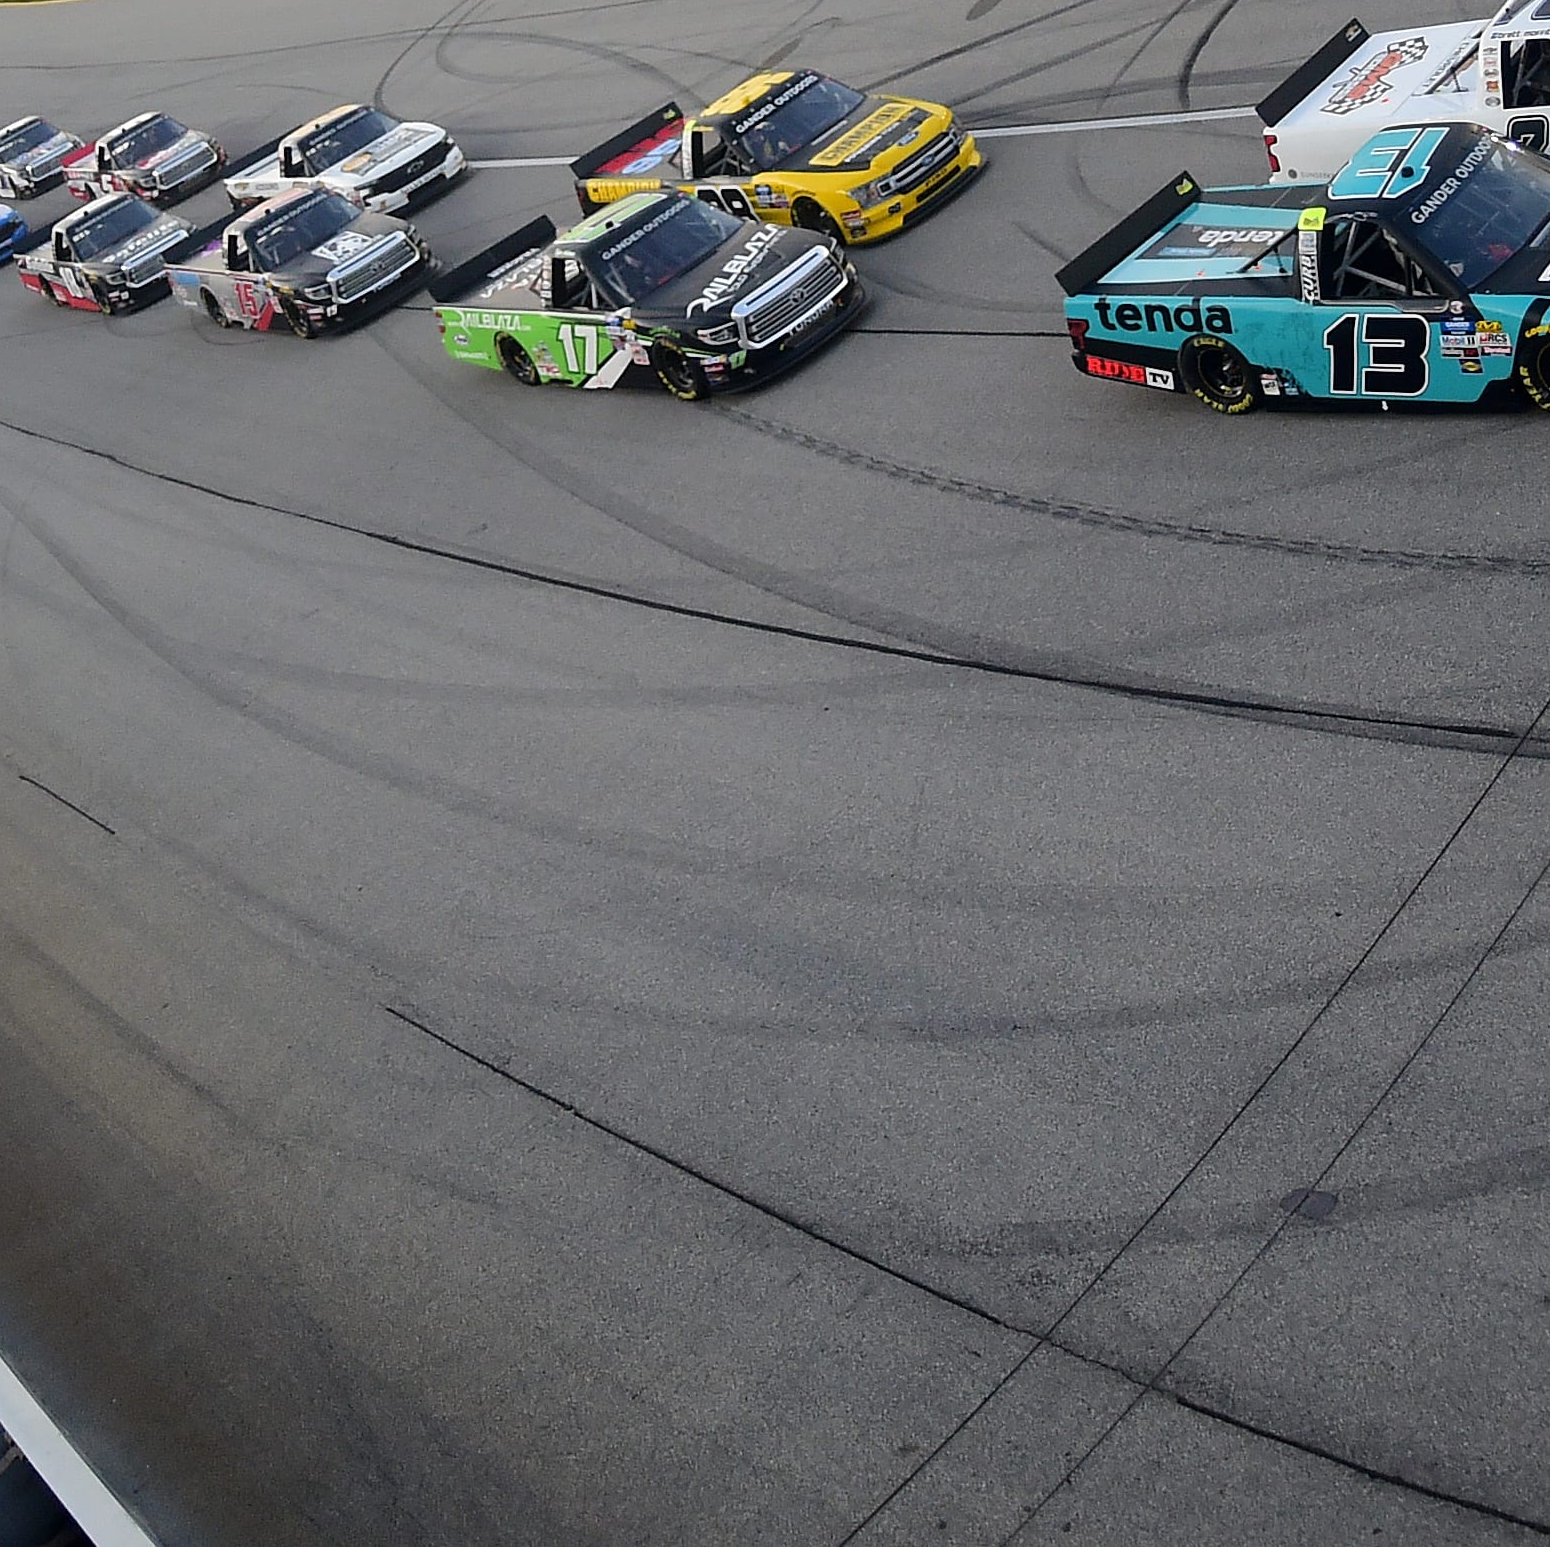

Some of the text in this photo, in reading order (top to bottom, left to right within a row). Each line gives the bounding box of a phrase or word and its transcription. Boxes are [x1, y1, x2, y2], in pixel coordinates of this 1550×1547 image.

[735, 74, 819, 134] GANDER OUTDOORS
[1328, 127, 1450, 200] 13
[1411, 177, 1462, 226] GANDER
[601, 198, 691, 261] GANDER OUTDOORS
[1198, 229, 1285, 247] tenda
[235, 281, 259, 317] 15
[788, 298, 835, 337] TUNDRA
[1094, 296, 1234, 334] tenda
[557, 323, 599, 375] 17
[1193, 337, 1225, 349] EAGLE
[1323, 313, 1431, 397] 13
[1086, 355, 1147, 384] RIDE
